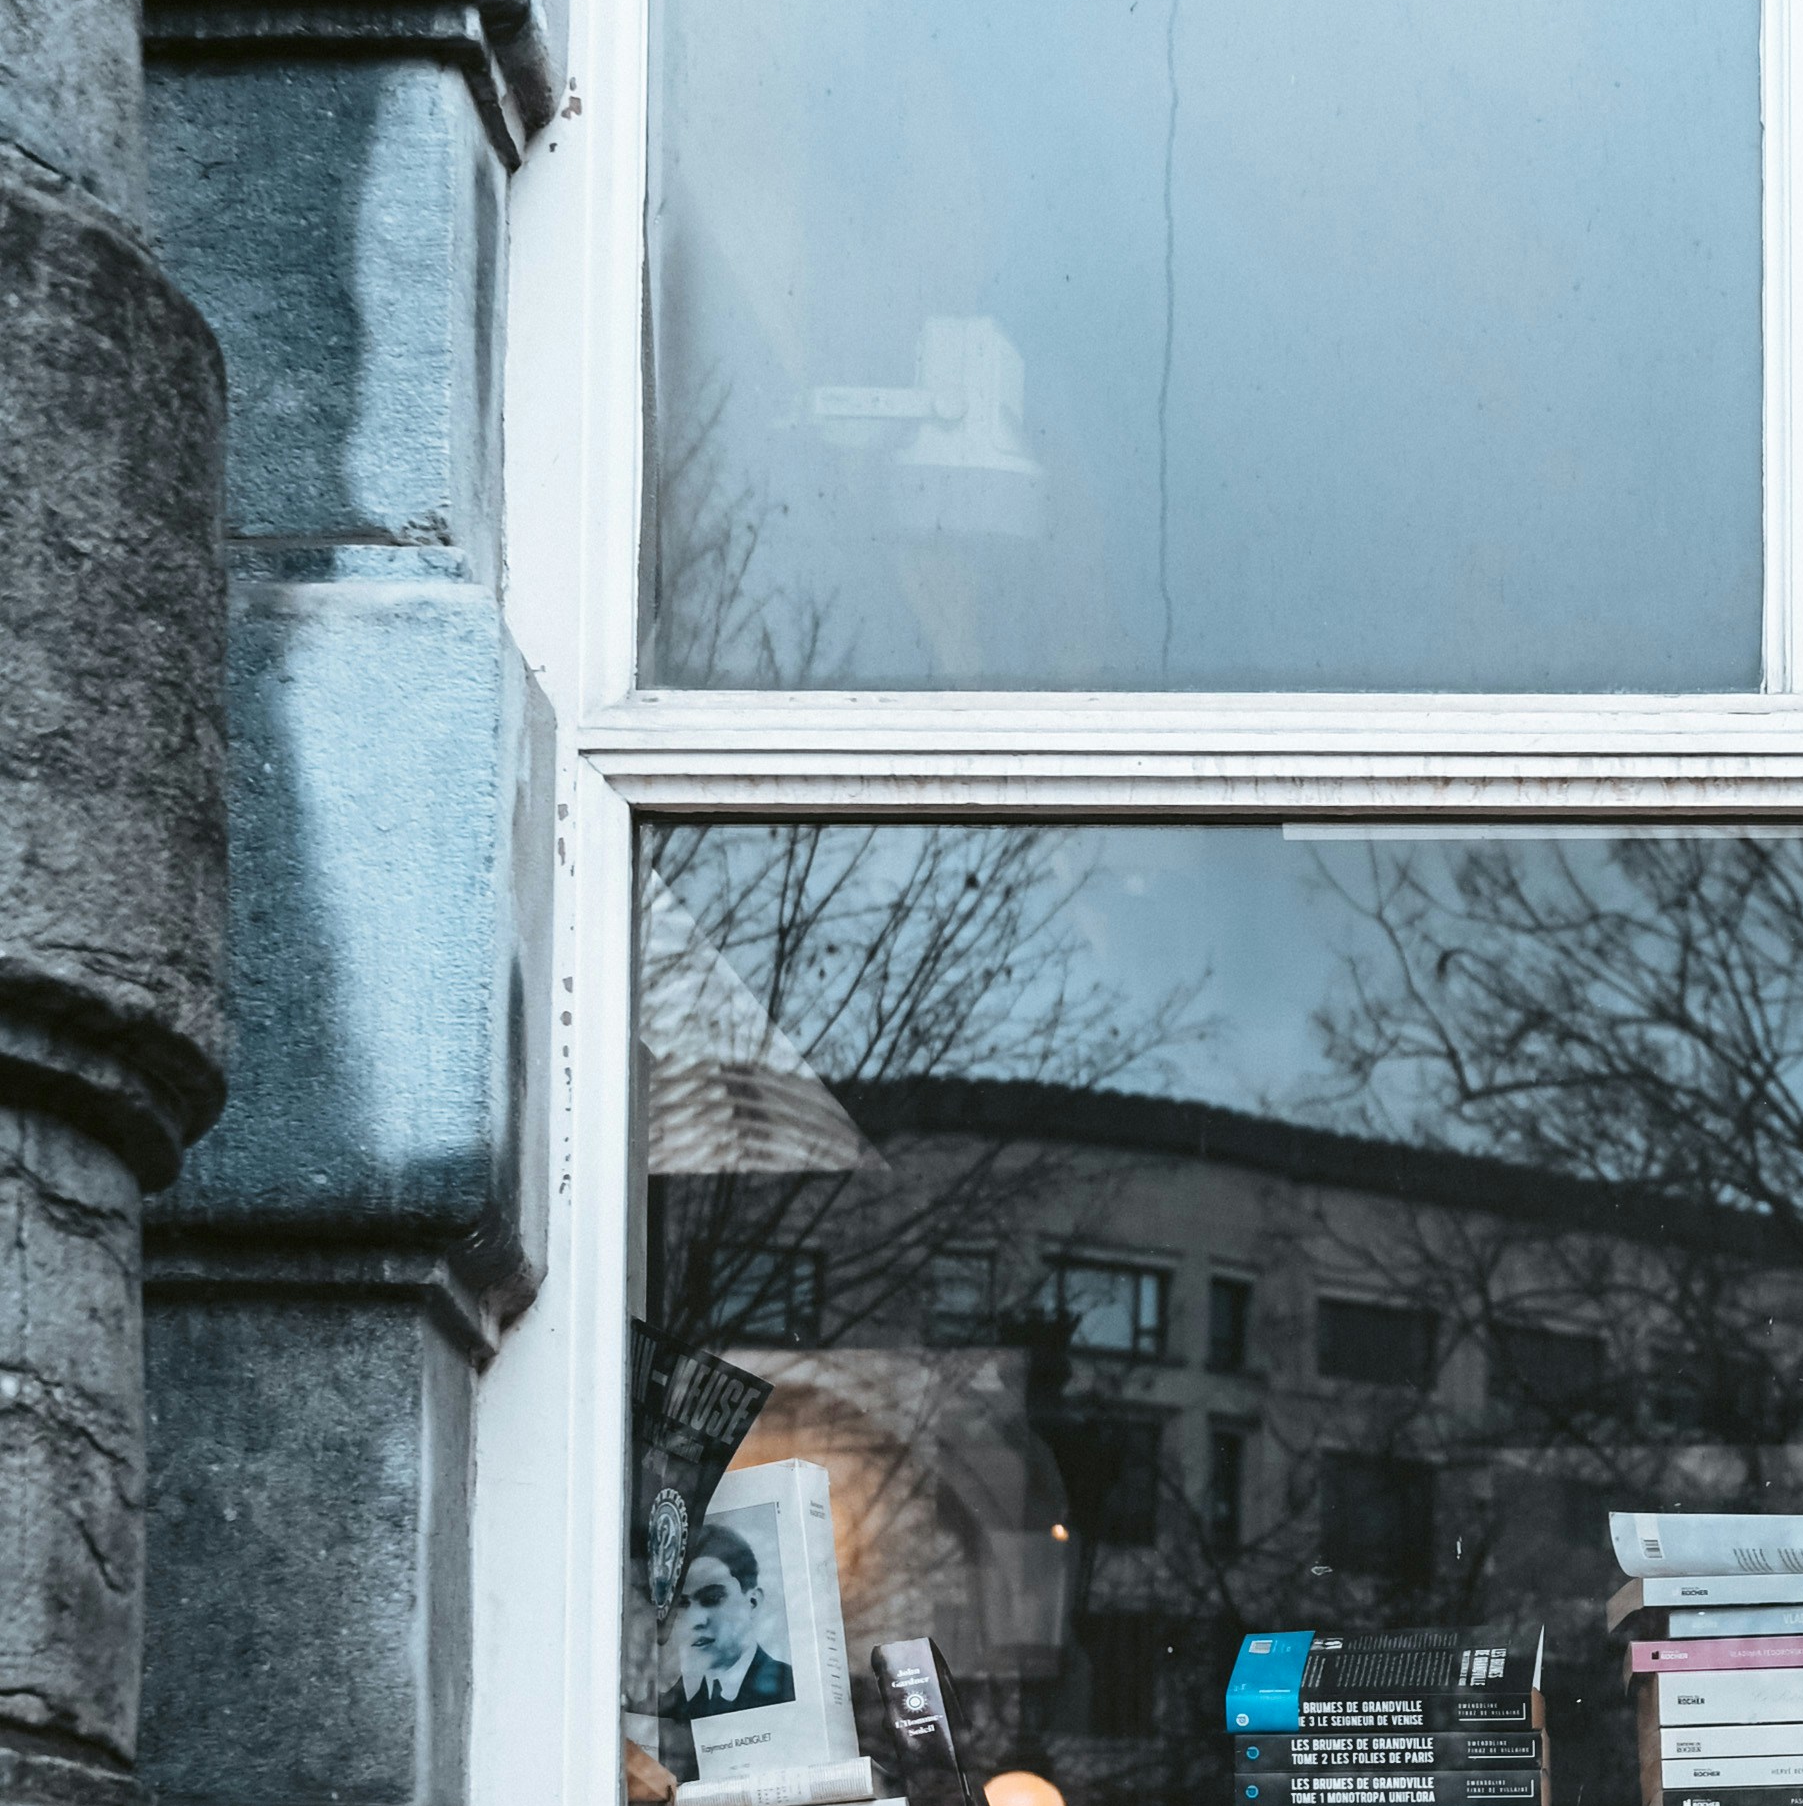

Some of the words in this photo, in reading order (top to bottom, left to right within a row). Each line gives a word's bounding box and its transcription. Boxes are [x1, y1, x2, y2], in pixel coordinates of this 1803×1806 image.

[1291, 1739, 1308, 1751] LES
[1311, 1739, 1349, 1751] BRUMES
[1353, 1738, 1365, 1750] DE
[1368, 1737, 1434, 1750] GRANDVILLE
[1292, 1753, 1318, 1765] TOME
[1321, 1753, 1329, 1764] 2
[1331, 1752, 1349, 1764] LES
[1352, 1752, 1384, 1764] FOLIES
[1388, 1752, 1401, 1763] DE
[1404, 1751, 1434, 1764] PARIS
